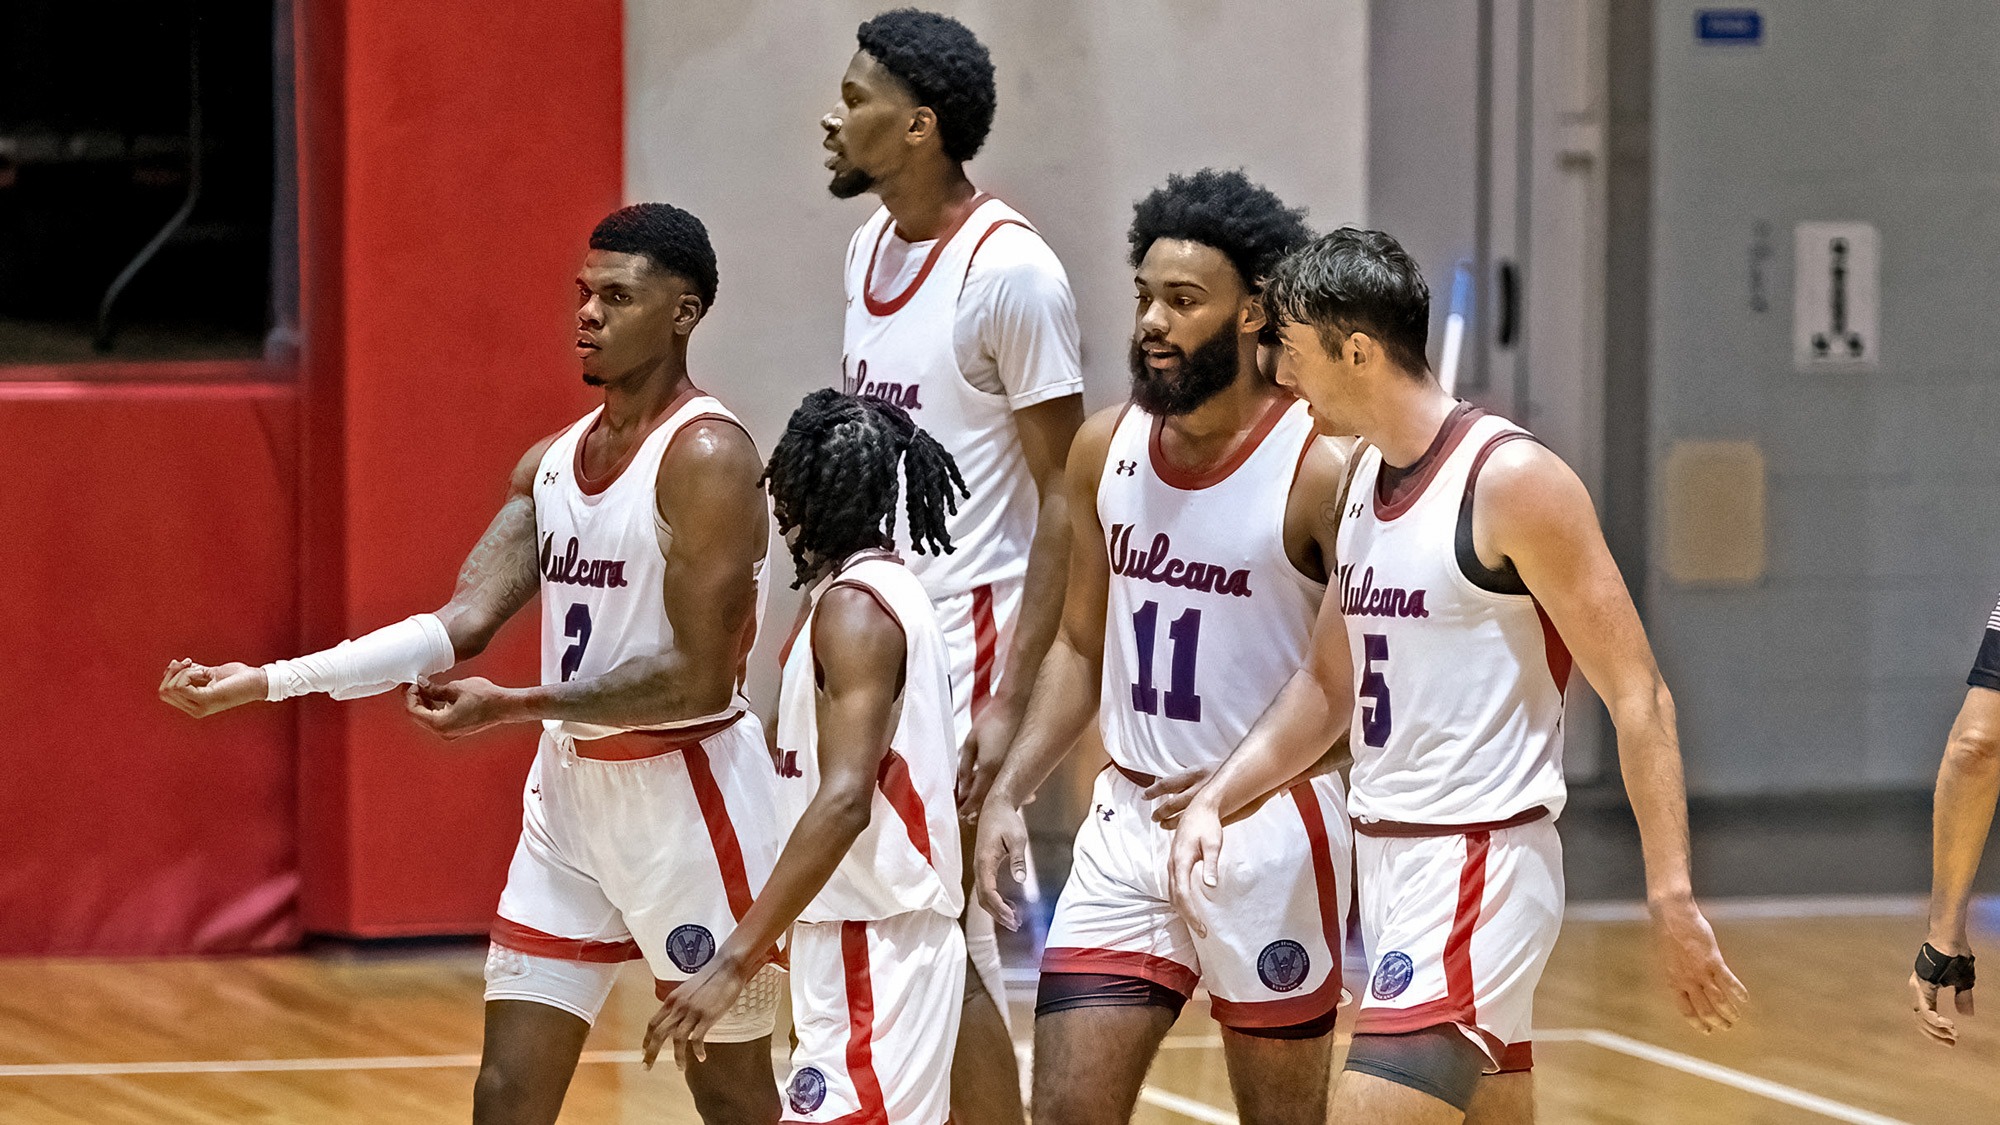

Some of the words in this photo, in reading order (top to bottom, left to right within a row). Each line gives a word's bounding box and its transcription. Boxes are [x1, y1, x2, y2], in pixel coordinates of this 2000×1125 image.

[561, 603, 592, 682] 2
[1131, 600, 1202, 722] 11
[1359, 634, 1392, 748] 5
